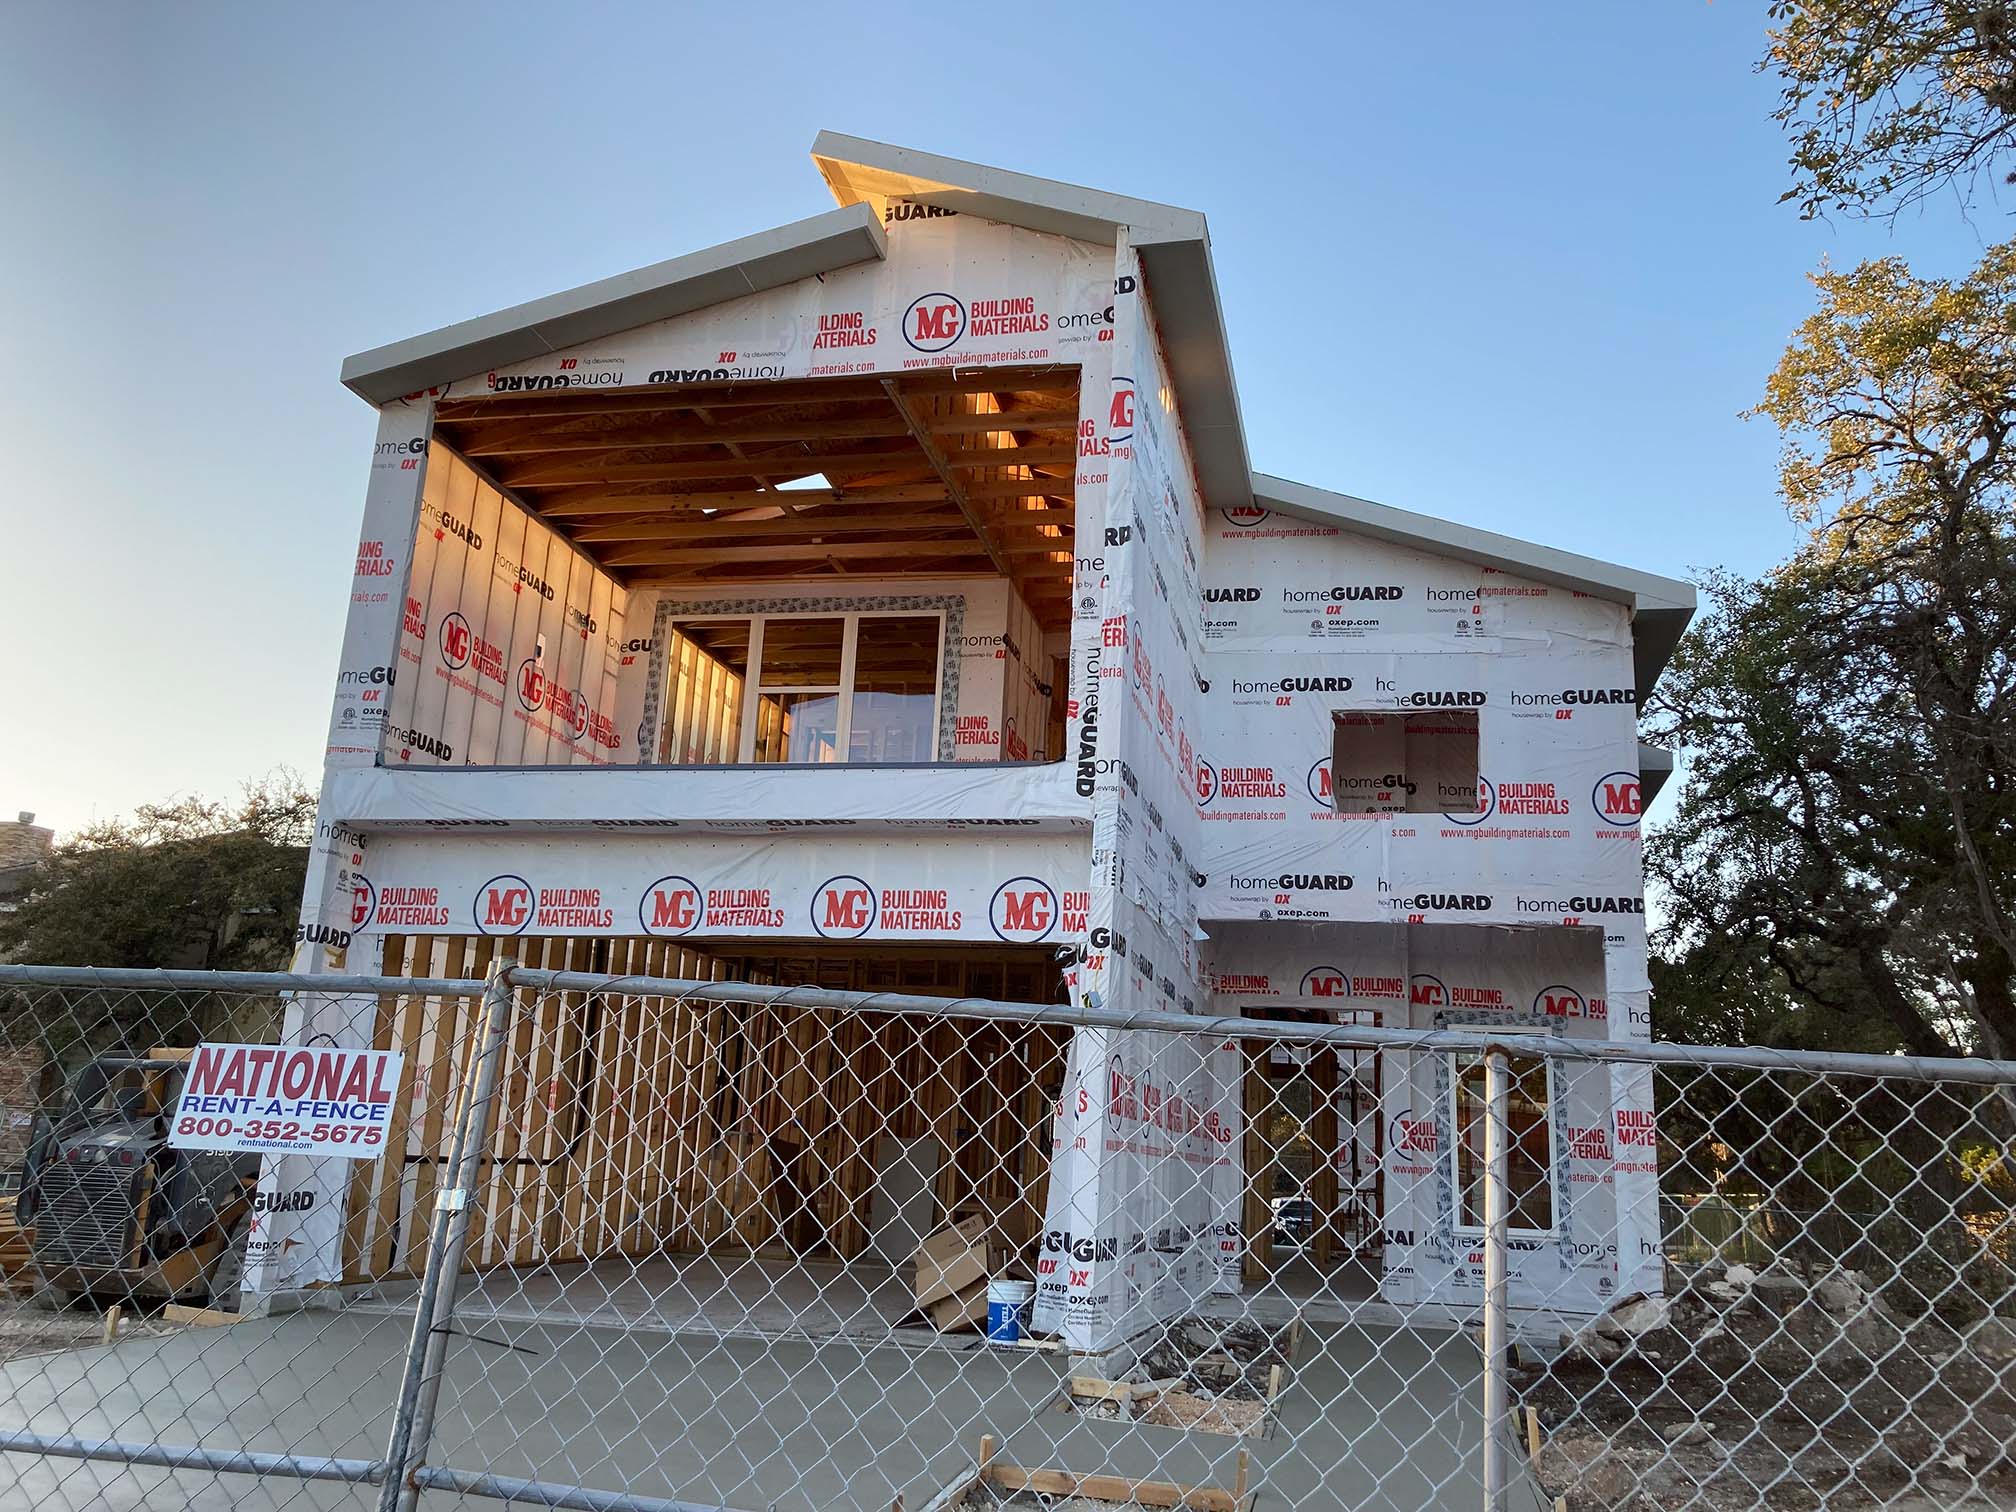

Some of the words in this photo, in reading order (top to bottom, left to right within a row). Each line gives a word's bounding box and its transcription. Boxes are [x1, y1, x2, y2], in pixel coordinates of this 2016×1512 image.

[971, 297, 1034, 318] BUILDING
[818, 312, 862, 331] ILDING
[915, 304, 959, 340] MG
[970, 313, 1049, 337] MATERIALS
[903, 348, 1048, 368] www.mgbuildingmaterials.com
[400, 459, 418, 470] OX
[1222, 528, 1339, 540] www.mgbuildingmaterials.com
[1283, 586, 1404, 602] homeGUARD
[1326, 605, 1343, 615] OX
[1328, 619, 1380, 629] oxep.com
[1233, 678, 1353, 694] homeGUARD
[362, 690, 382, 701] OX
[1275, 696, 1292, 706] OX
[1511, 689, 1636, 706] homeGUARD
[1555, 709, 1573, 720] OX
[1221, 768, 1273, 782] BUILDING
[1221, 783, 1286, 798] MATERIALS
[1377, 792, 1392, 801] OX
[1499, 784, 1555, 798] BUILDING
[1499, 800, 1569, 815] MATERIALS
[1604, 784, 1641, 815] MG
[1441, 827, 1570, 840] www.mgbuildingmaterials.com
[1230, 874, 1354, 890] homeGUARD
[380, 887, 439, 906] BUILDING
[539, 888, 600, 908] BUILDING
[708, 889, 770, 908] BUILDING
[882, 889, 947, 909] BUILDING
[1274, 894, 1292, 904] OX
[1517, 896, 1645, 913] homeGUARD
[484, 888, 528, 926] MG
[650, 889, 695, 928] MG
[823, 889, 868, 929] MG
[1003, 891, 1049, 932] MG
[1277, 909, 1330, 918] oxep.com
[376, 907, 449, 926] MATERIALS
[536, 908, 613, 928] MATERIALS
[706, 909, 785, 928] MATERIALS
[880, 911, 962, 931] MATERIALS
[1353, 977, 1404, 992] BUILDING
[1452, 987, 1503, 1004] BUILDING
[188, 1047, 392, 1104] NATIONAL
[181, 1095, 388, 1121] RENT-A-FENCE
[177, 1116, 383, 1145] 800-352-5675
[237, 1138, 313, 1150] rentnational.com
